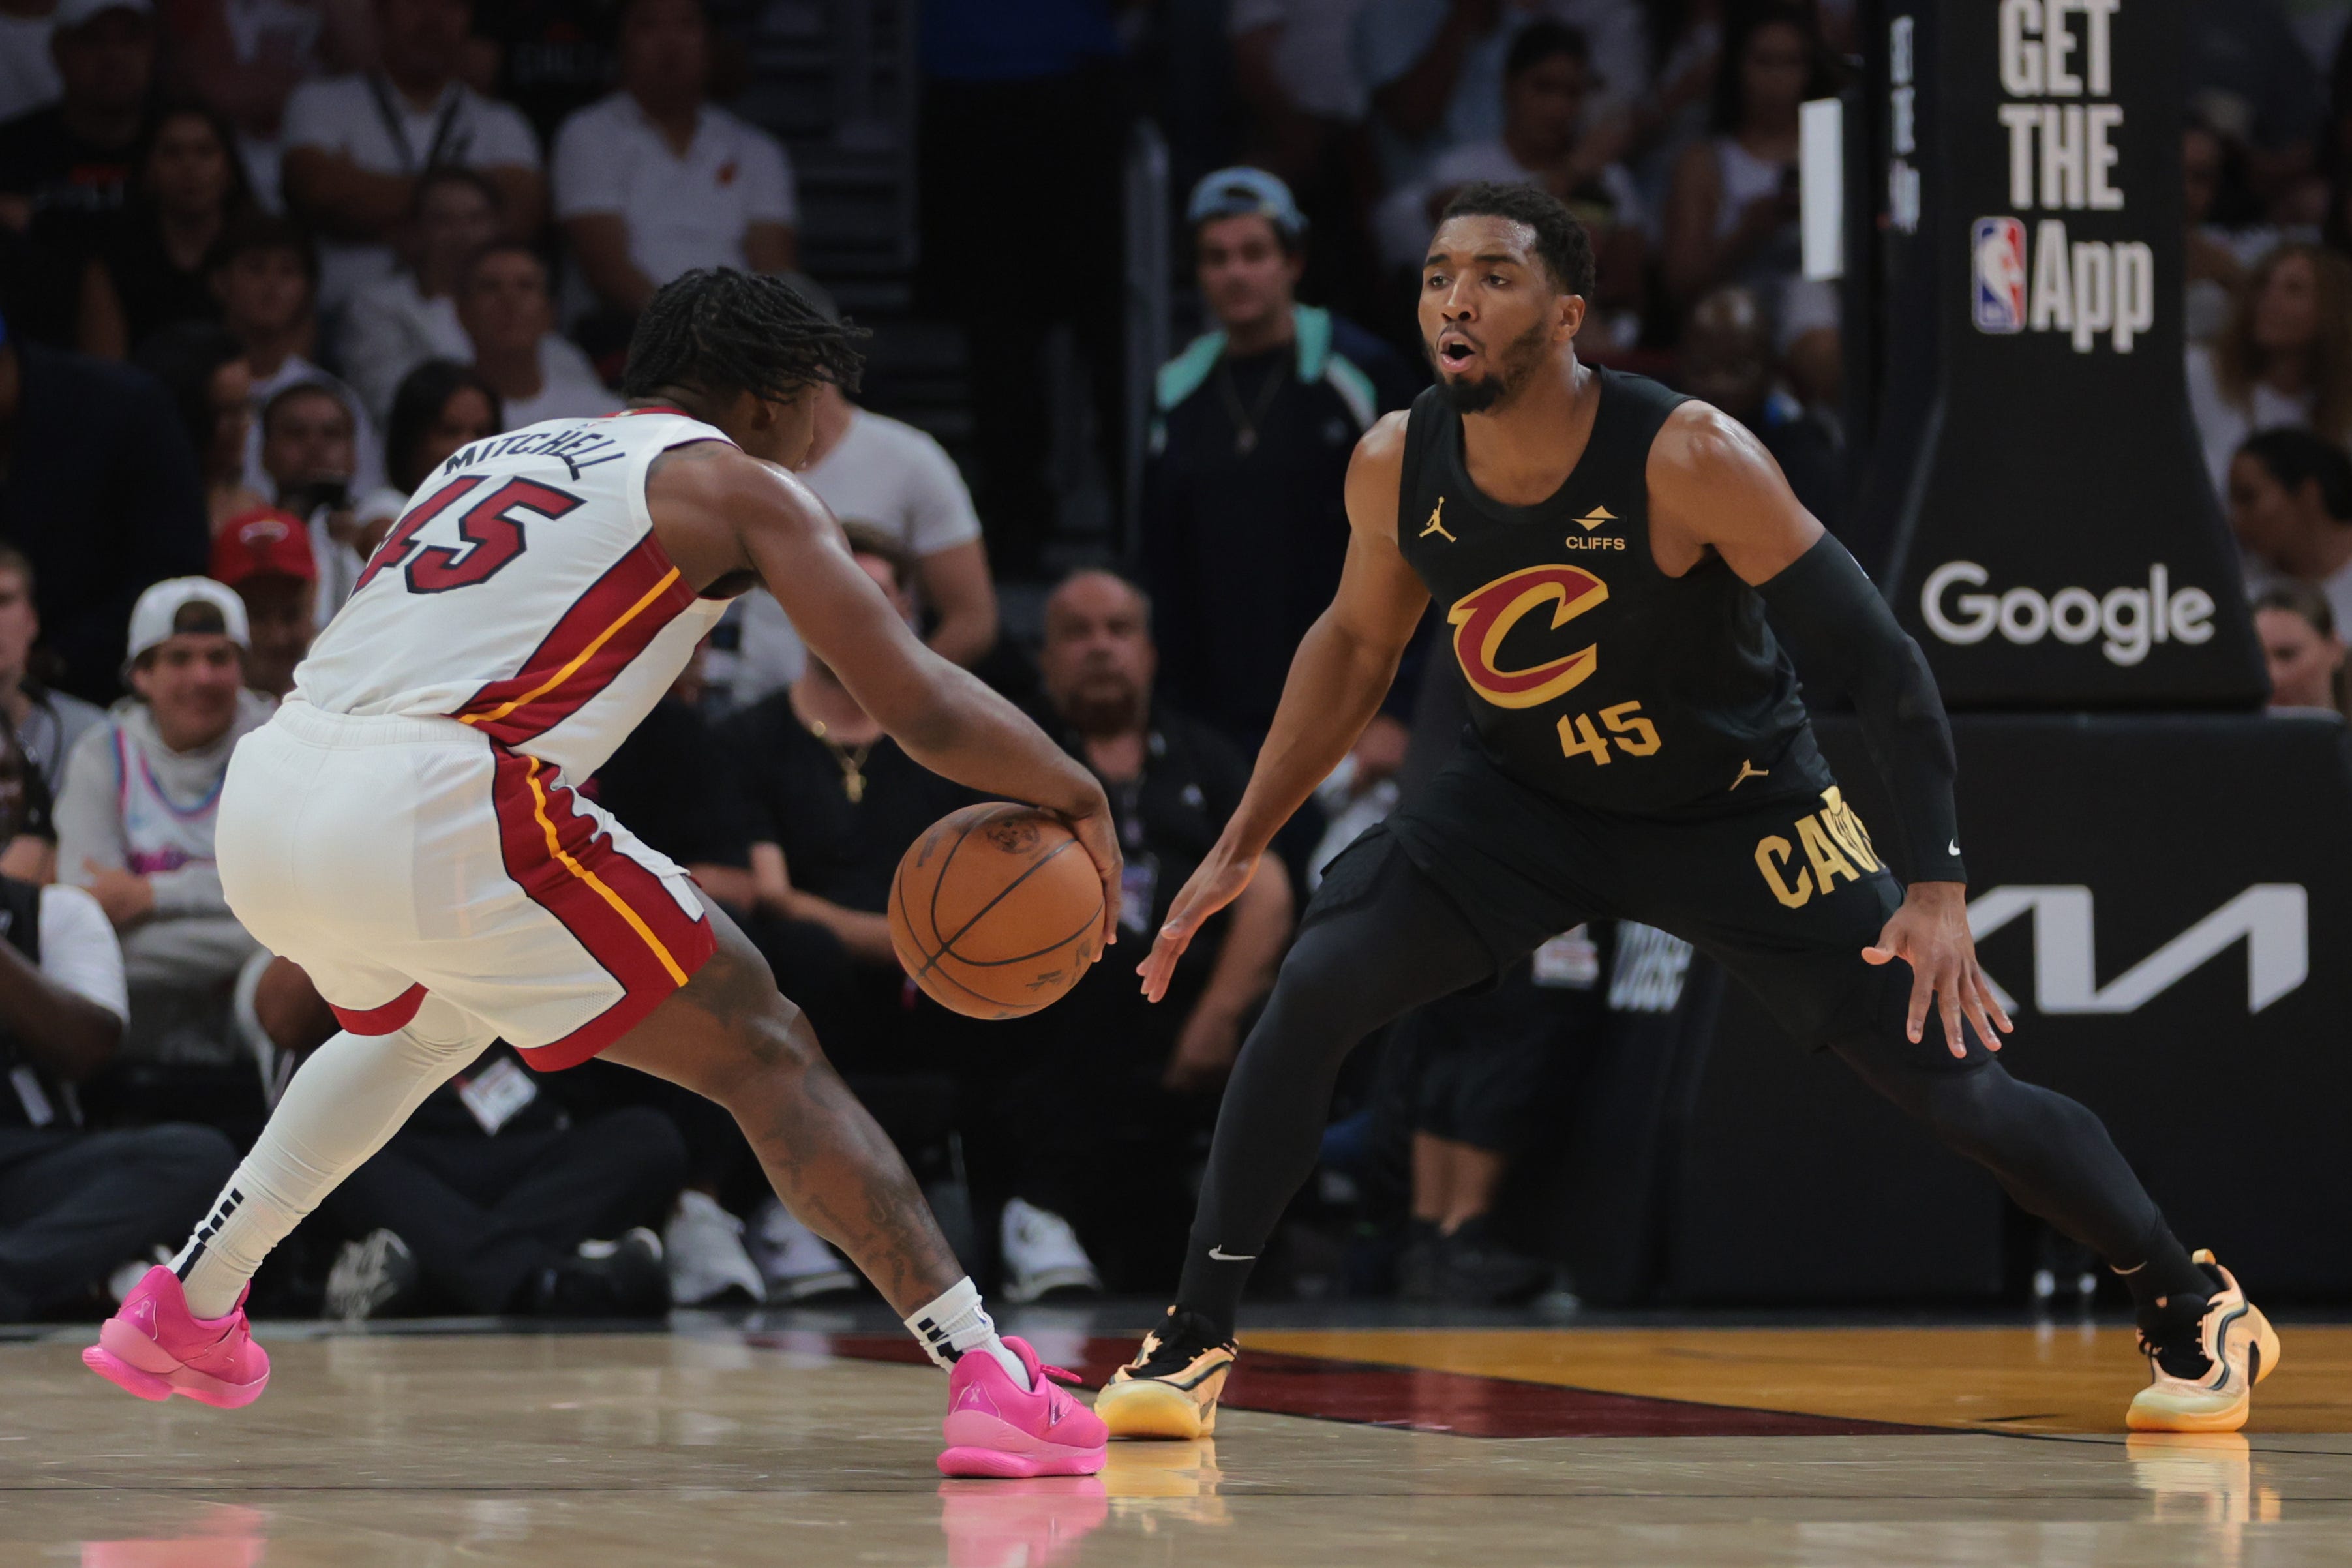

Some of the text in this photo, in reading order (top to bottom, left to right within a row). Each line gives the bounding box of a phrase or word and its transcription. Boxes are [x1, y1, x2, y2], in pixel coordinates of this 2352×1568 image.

[1999, 0, 2120, 97] GET
[1998, 104, 2124, 210] THE
[2029, 219, 2154, 353] App
[443, 429, 626, 481] MITCHELL
[1565, 535, 1626, 551] CLIFFS
[1447, 564, 1610, 709] C
[1920, 560, 2216, 666] Google
[1556, 700, 1662, 766] 45
